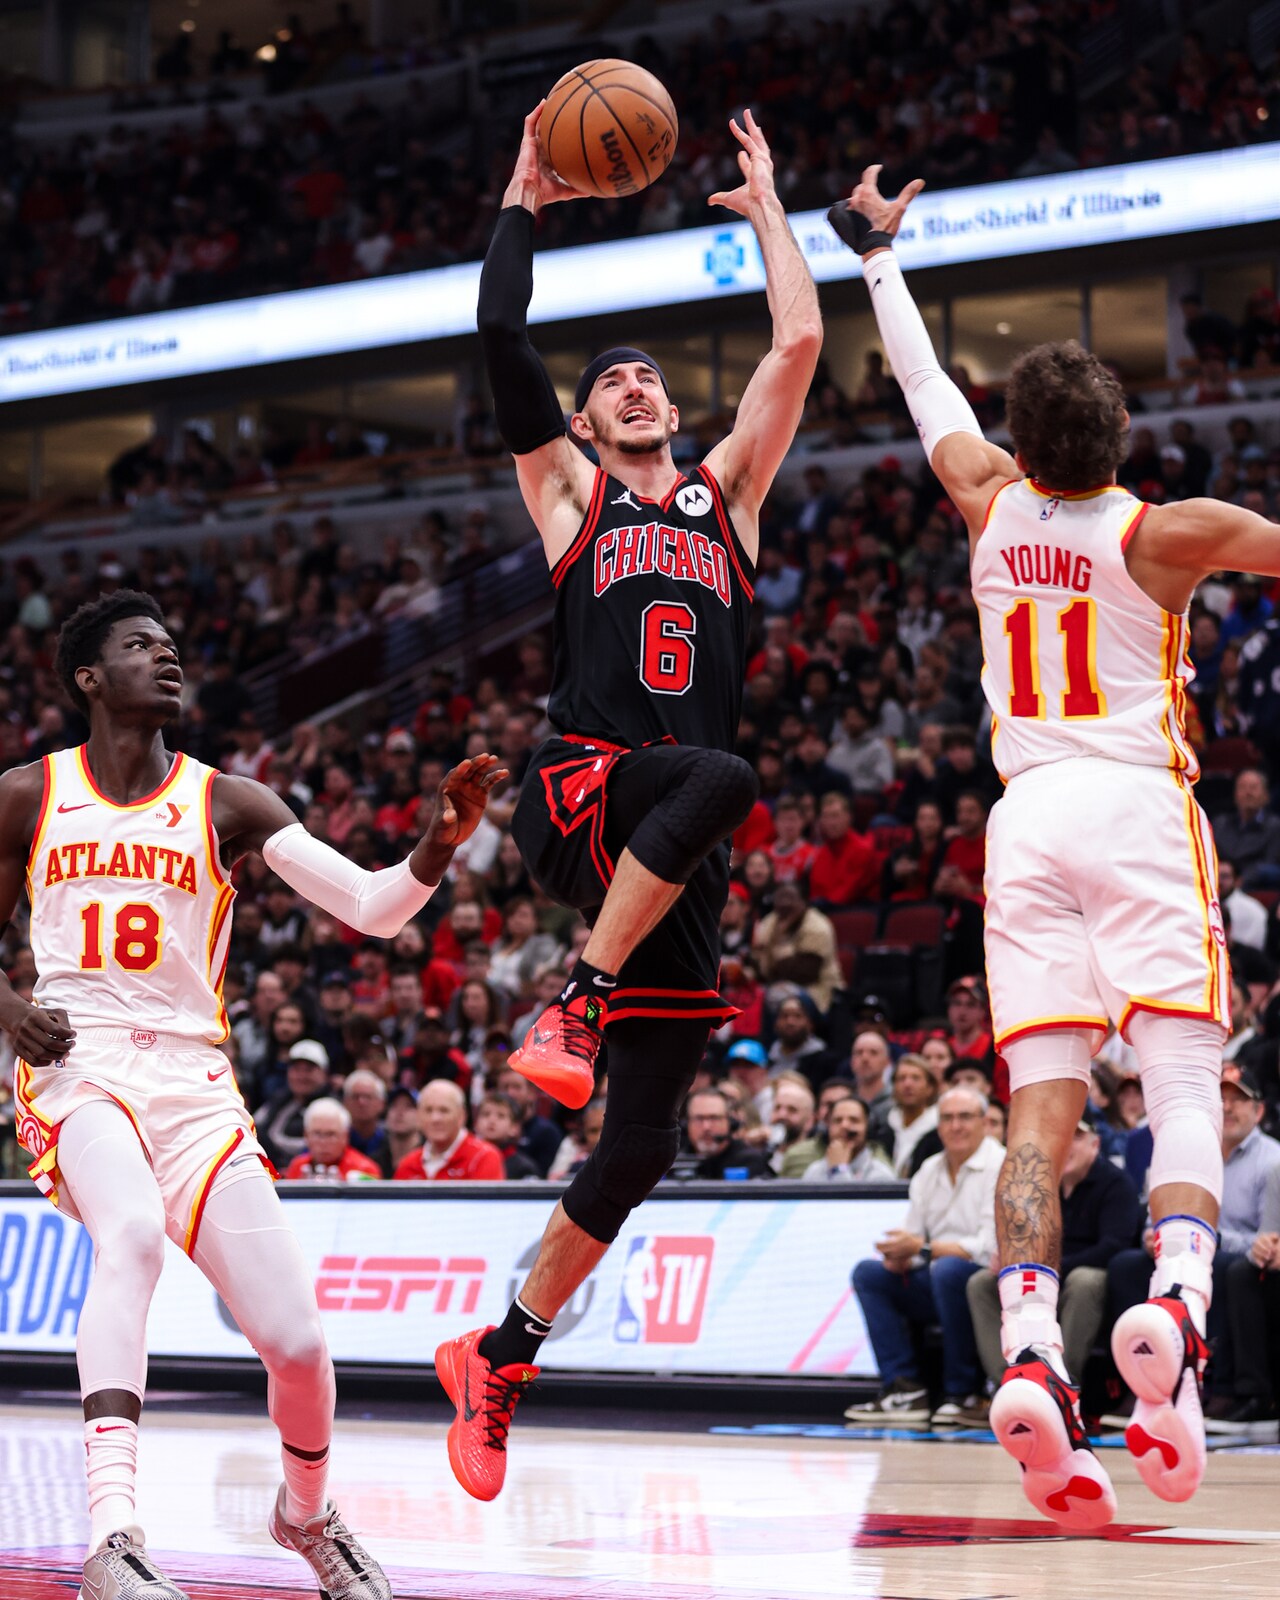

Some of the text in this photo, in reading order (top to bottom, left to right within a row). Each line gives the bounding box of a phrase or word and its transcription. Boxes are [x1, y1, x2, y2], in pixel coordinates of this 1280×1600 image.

[594, 521, 732, 609] CHICAGO
[1000, 544, 1092, 593] YOUNG
[639, 600, 697, 696] 6
[1003, 597, 1109, 722] 11
[45, 842, 198, 897] ATLANTA
[80, 901, 164, 973] 18
[130, 1029, 157, 1042] HAWKS
[316, 1255, 487, 1313] ESPN
[656, 1253, 707, 1326] TV
